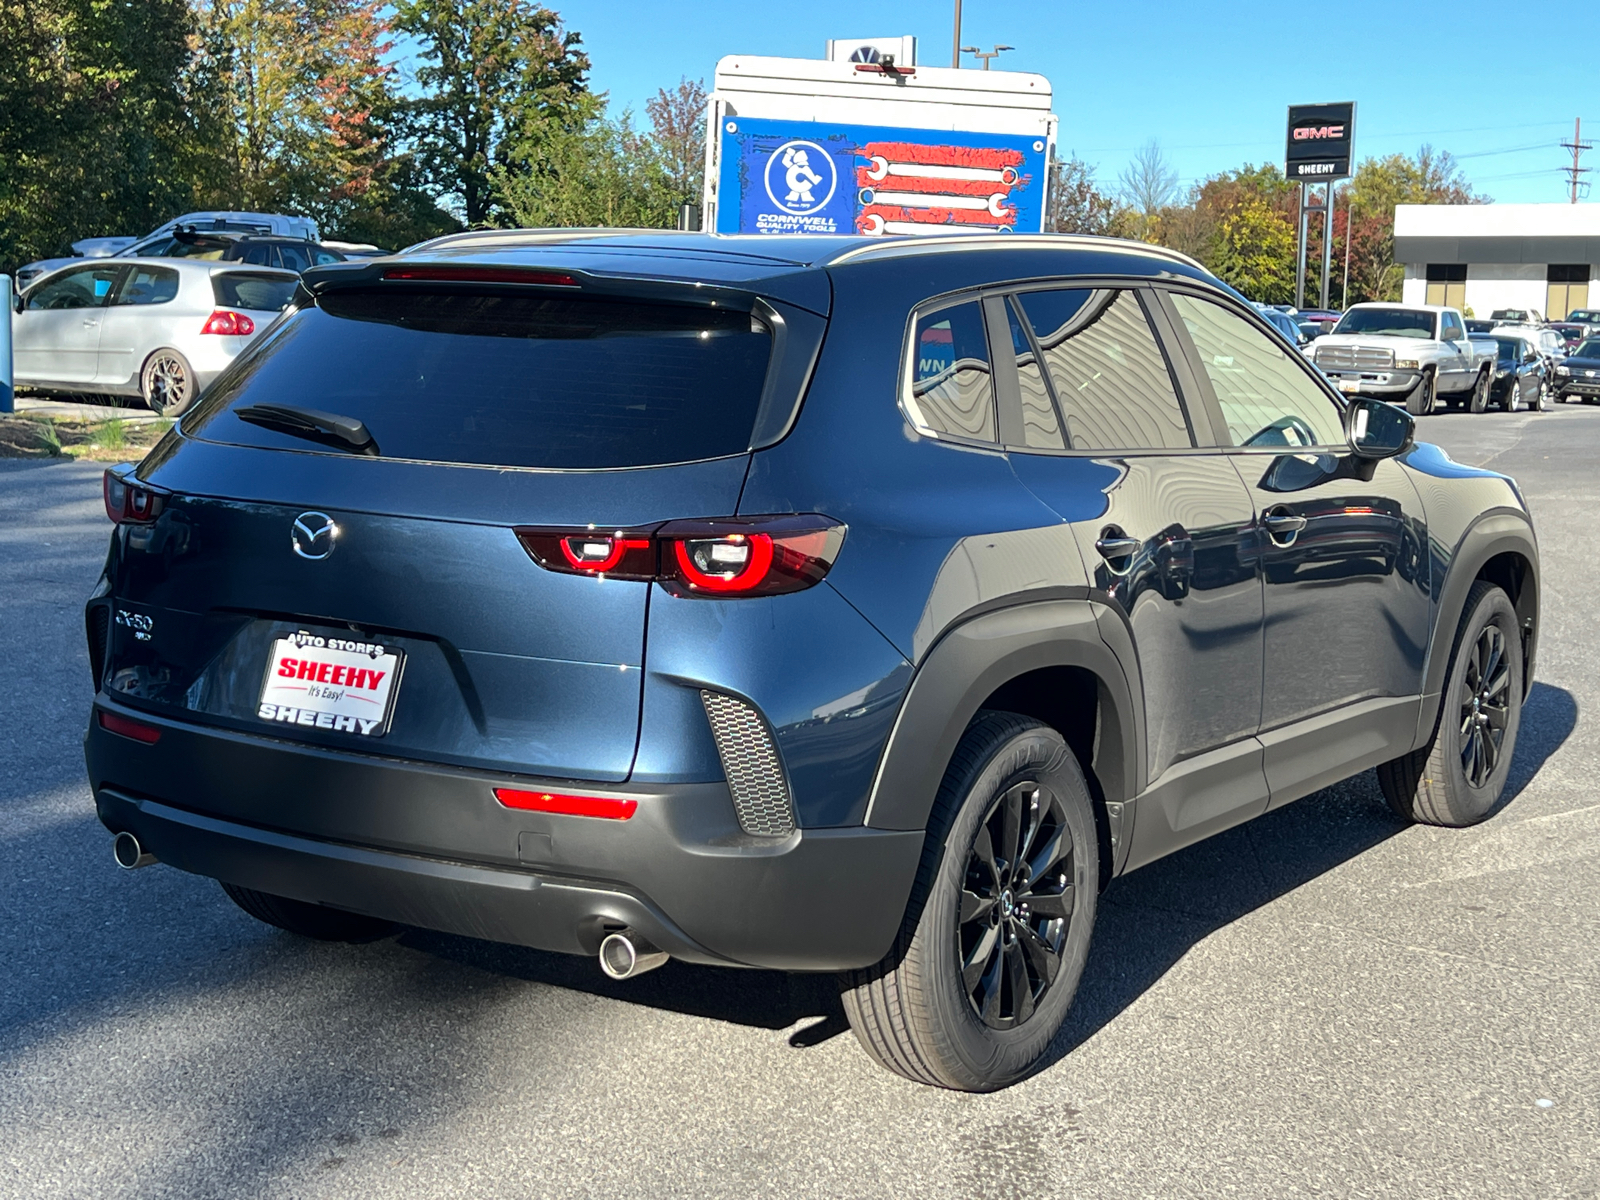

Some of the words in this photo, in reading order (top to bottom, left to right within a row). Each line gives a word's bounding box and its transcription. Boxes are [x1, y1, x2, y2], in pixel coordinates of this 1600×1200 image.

[1293, 125, 1344, 140] GMC
[1298, 163, 1335, 174] SHEEHY
[757, 213, 836, 226] CORNWELL
[756, 221, 800, 230] QUALITY
[803, 224, 837, 233] TOOLS
[287, 633, 325, 647] AUTO
[277, 657, 386, 691] SHEEHY
[308, 685, 320, 698] It's
[321, 687, 345, 702] Easy!
[258, 703, 379, 735] SHEEHY
